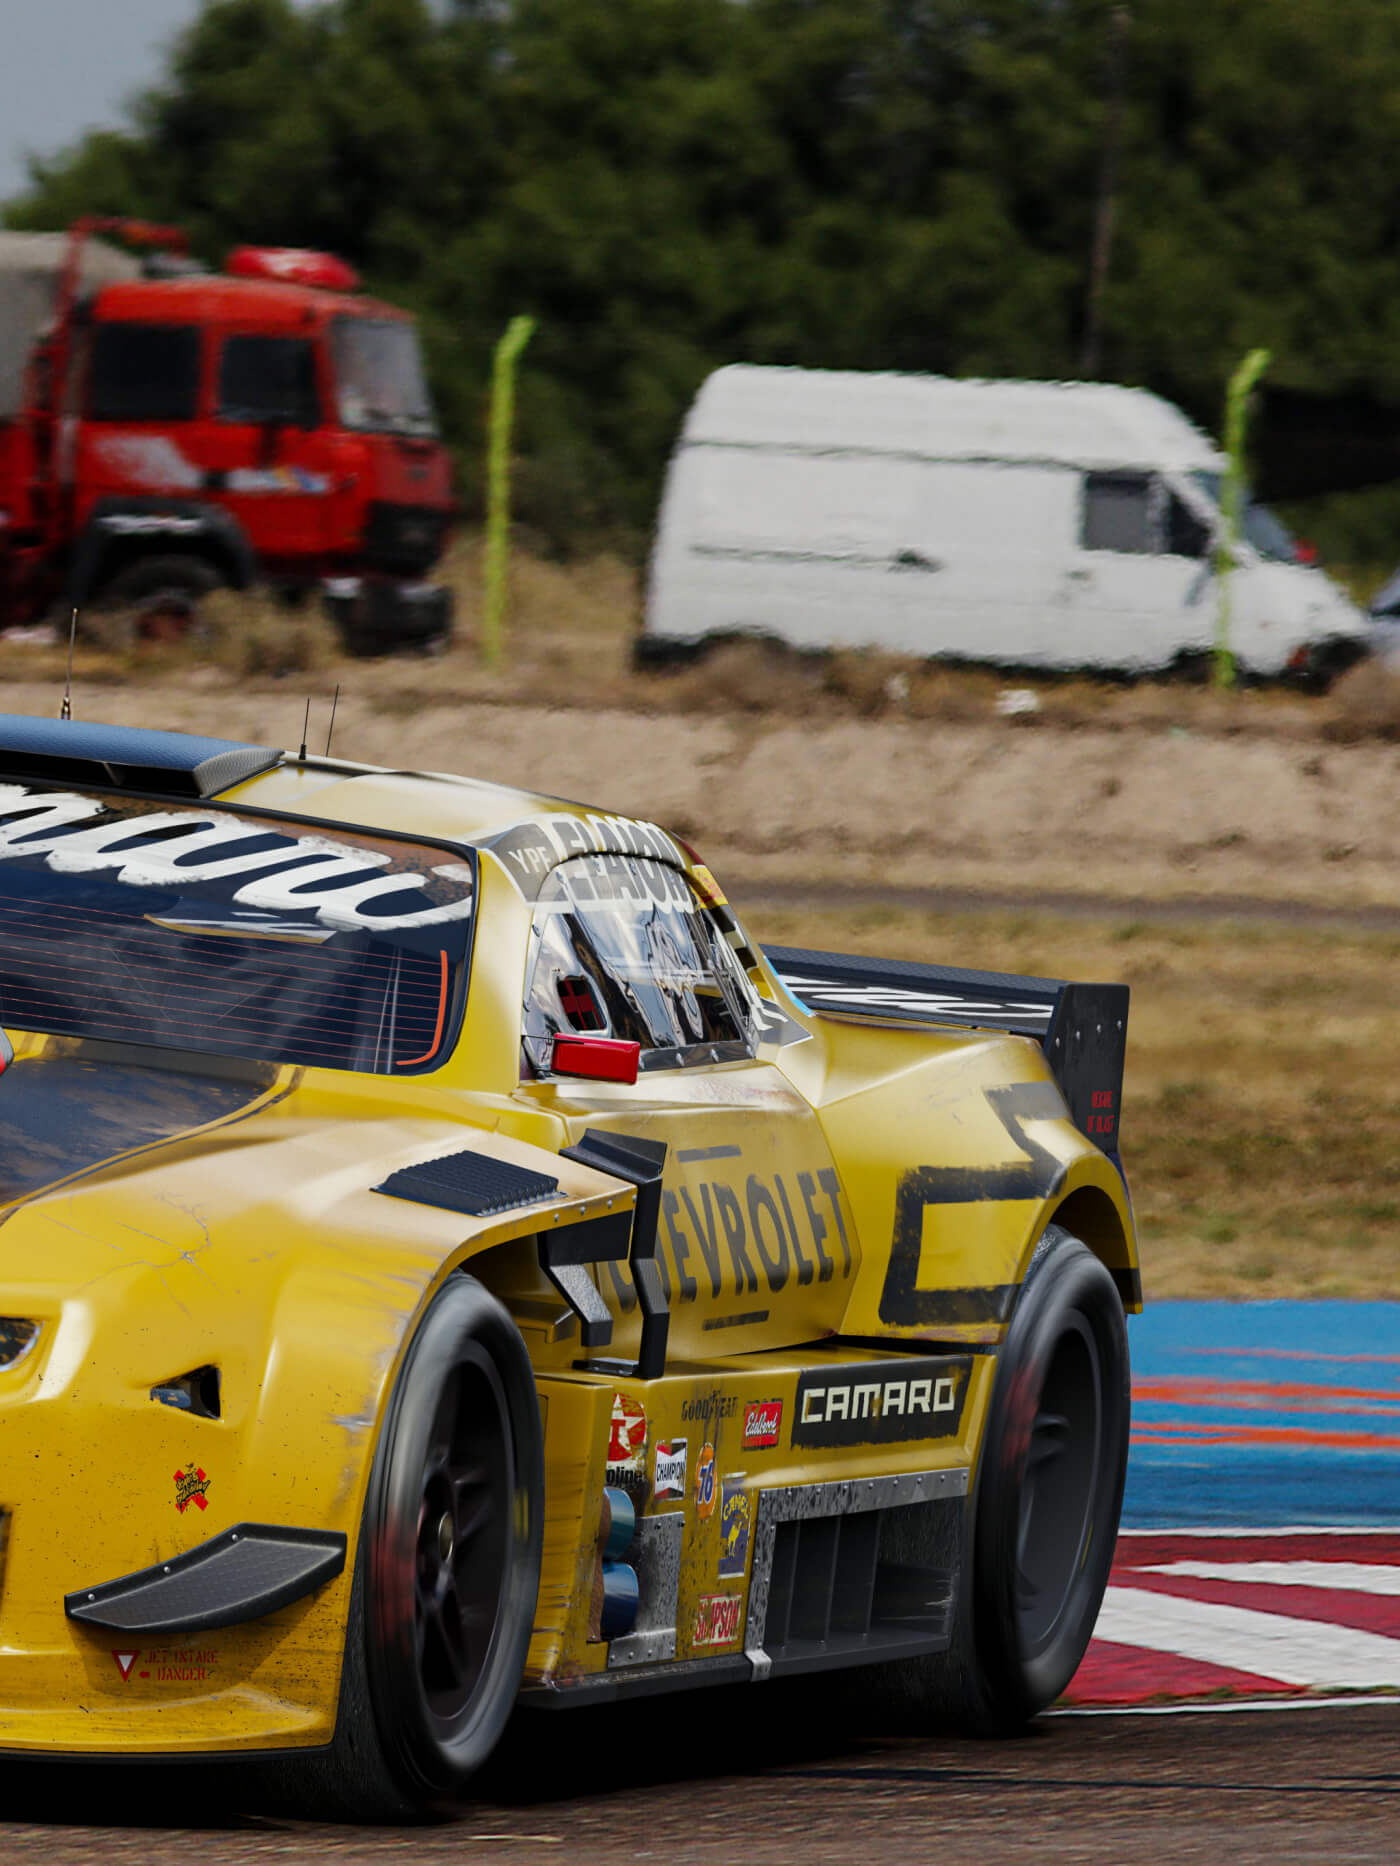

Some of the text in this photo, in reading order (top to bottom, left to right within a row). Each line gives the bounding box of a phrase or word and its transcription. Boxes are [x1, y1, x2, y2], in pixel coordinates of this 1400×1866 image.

[508, 847, 550, 874] YPF
[608, 1167, 851, 1315] EVROLET
[800, 1376, 956, 1425] CAMARO
[656, 1461, 686, 1482] CHAMPION
[697, 1461, 714, 1505] 76
[722, 1494, 749, 1521] CAMEL
